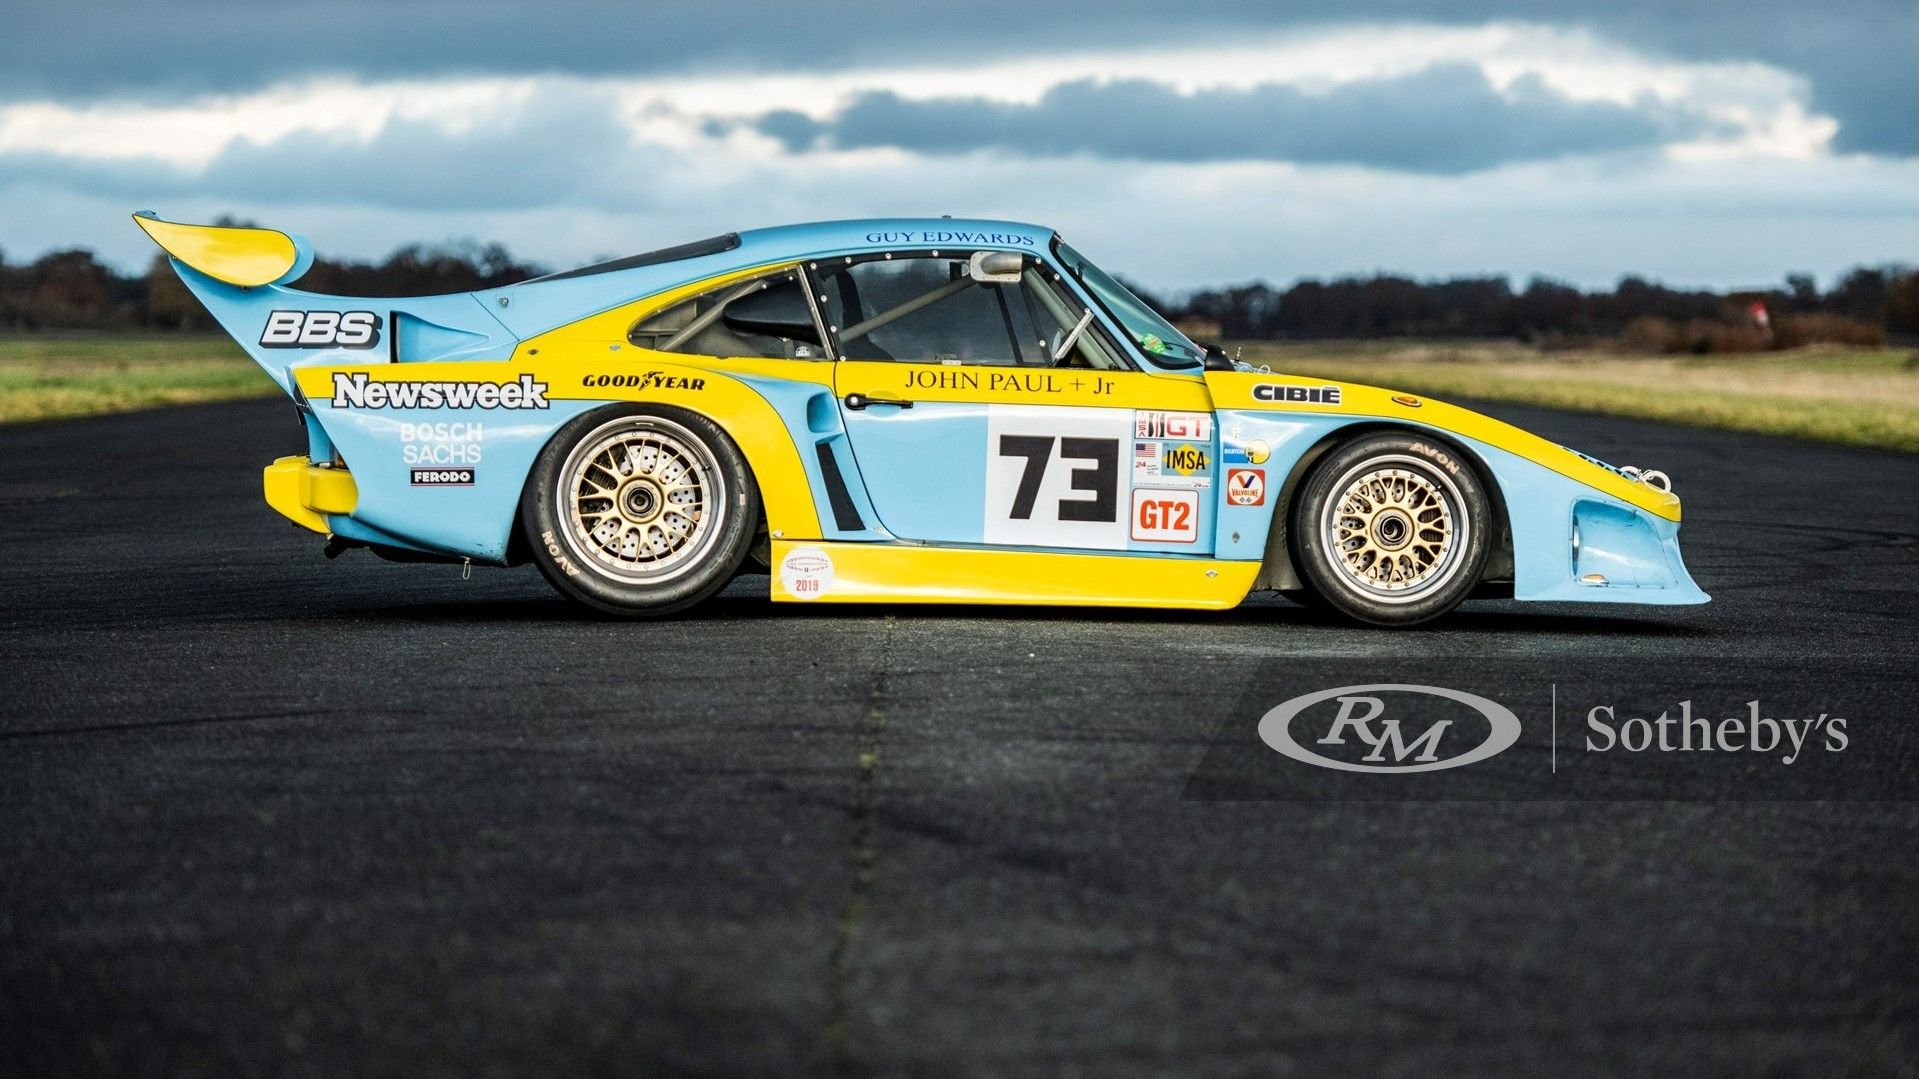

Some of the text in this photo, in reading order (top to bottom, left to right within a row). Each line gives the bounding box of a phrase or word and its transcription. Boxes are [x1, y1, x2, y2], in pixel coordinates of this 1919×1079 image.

[866, 231, 1034, 246] GUY EDWARDS
[259, 310, 381, 349] BBS
[332, 372, 550, 409] Newsweek
[905, 370, 1115, 395] JOHN PAUL + Jr
[400, 422, 483, 442] BOSCH
[1166, 415, 1209, 438] GT
[402, 444, 482, 464] SACHS
[1166, 450, 1206, 470] IMSA
[1409, 442, 1460, 475] AVON
[414, 471, 472, 483] FERODO
[999, 434, 1120, 524] 73
[1231, 488, 1259, 497] VALVOLINE
[1139, 499, 1190, 531] GT2
[541, 530, 580, 576] AVON
[796, 579, 819, 592] 2019
